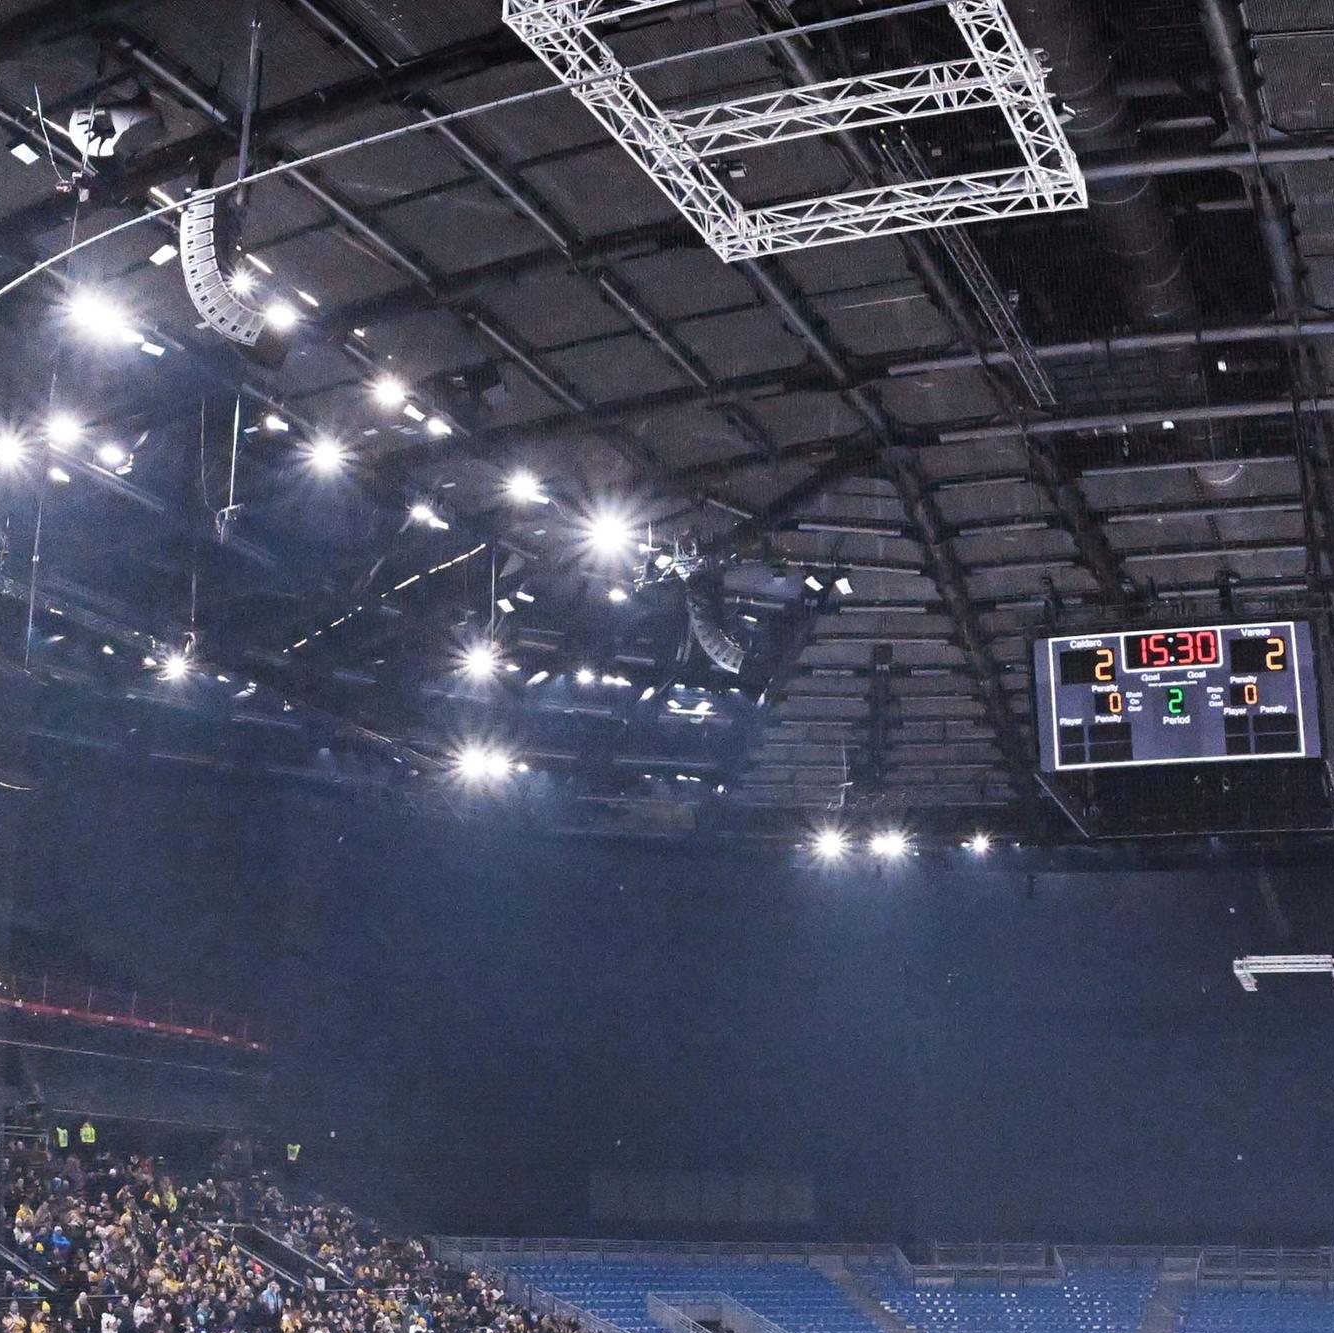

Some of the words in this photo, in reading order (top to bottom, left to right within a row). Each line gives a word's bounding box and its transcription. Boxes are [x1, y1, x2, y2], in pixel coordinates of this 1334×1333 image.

[1141, 631, 1216, 665] 15:30
[1266, 638, 1285, 671] 2
[1095, 649, 1113, 680] 2
[1141, 673, 1161, 682] Goal
[1187, 670, 1207, 679] Goal
[1230, 675, 1257, 684] Penalty
[1091, 684, 1119, 693] Penalty
[1244, 684, 1258, 704] 0
[1109, 692, 1122, 713] 0
[1168, 688, 1183, 713] 2
[1260, 705, 1287, 714] Penalty
[1095, 714, 1122, 723] Penalty
[1163, 715, 1191, 725] Period
